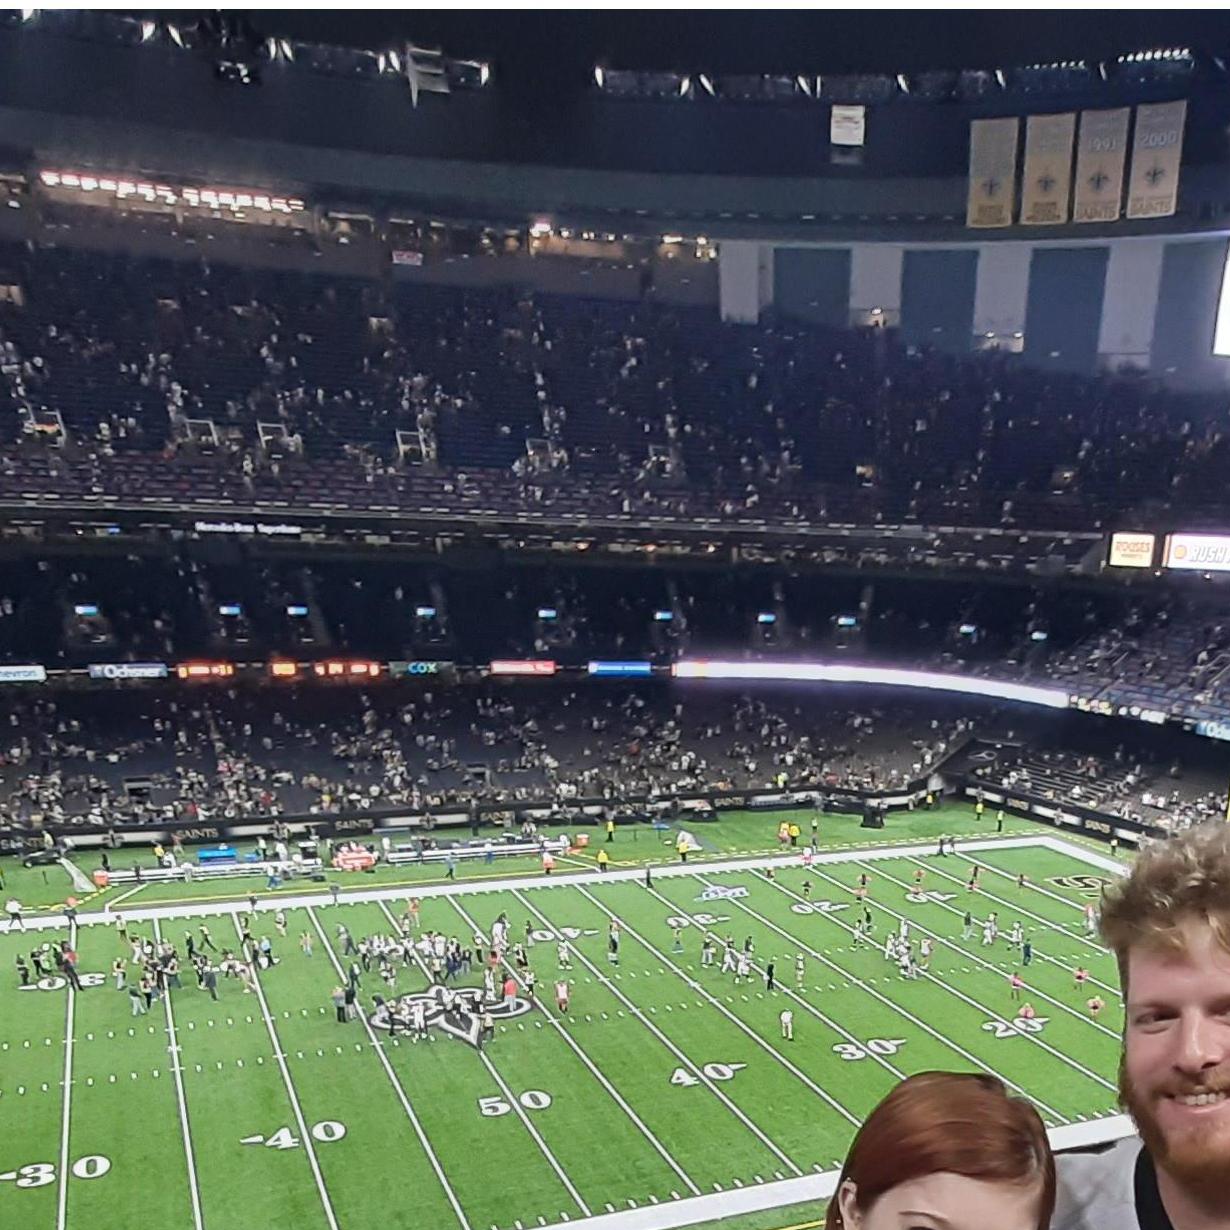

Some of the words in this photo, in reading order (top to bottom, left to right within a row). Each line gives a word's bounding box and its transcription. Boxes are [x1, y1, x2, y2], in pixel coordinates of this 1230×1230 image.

[1190, 545, 1227, 562] RUSH
[668, 1061, 736, 1087] 40
[478, 1090, 552, 1117] 50
[262, 1121, 347, 1150] 40
[15, 1154, 111, 1189] 30
